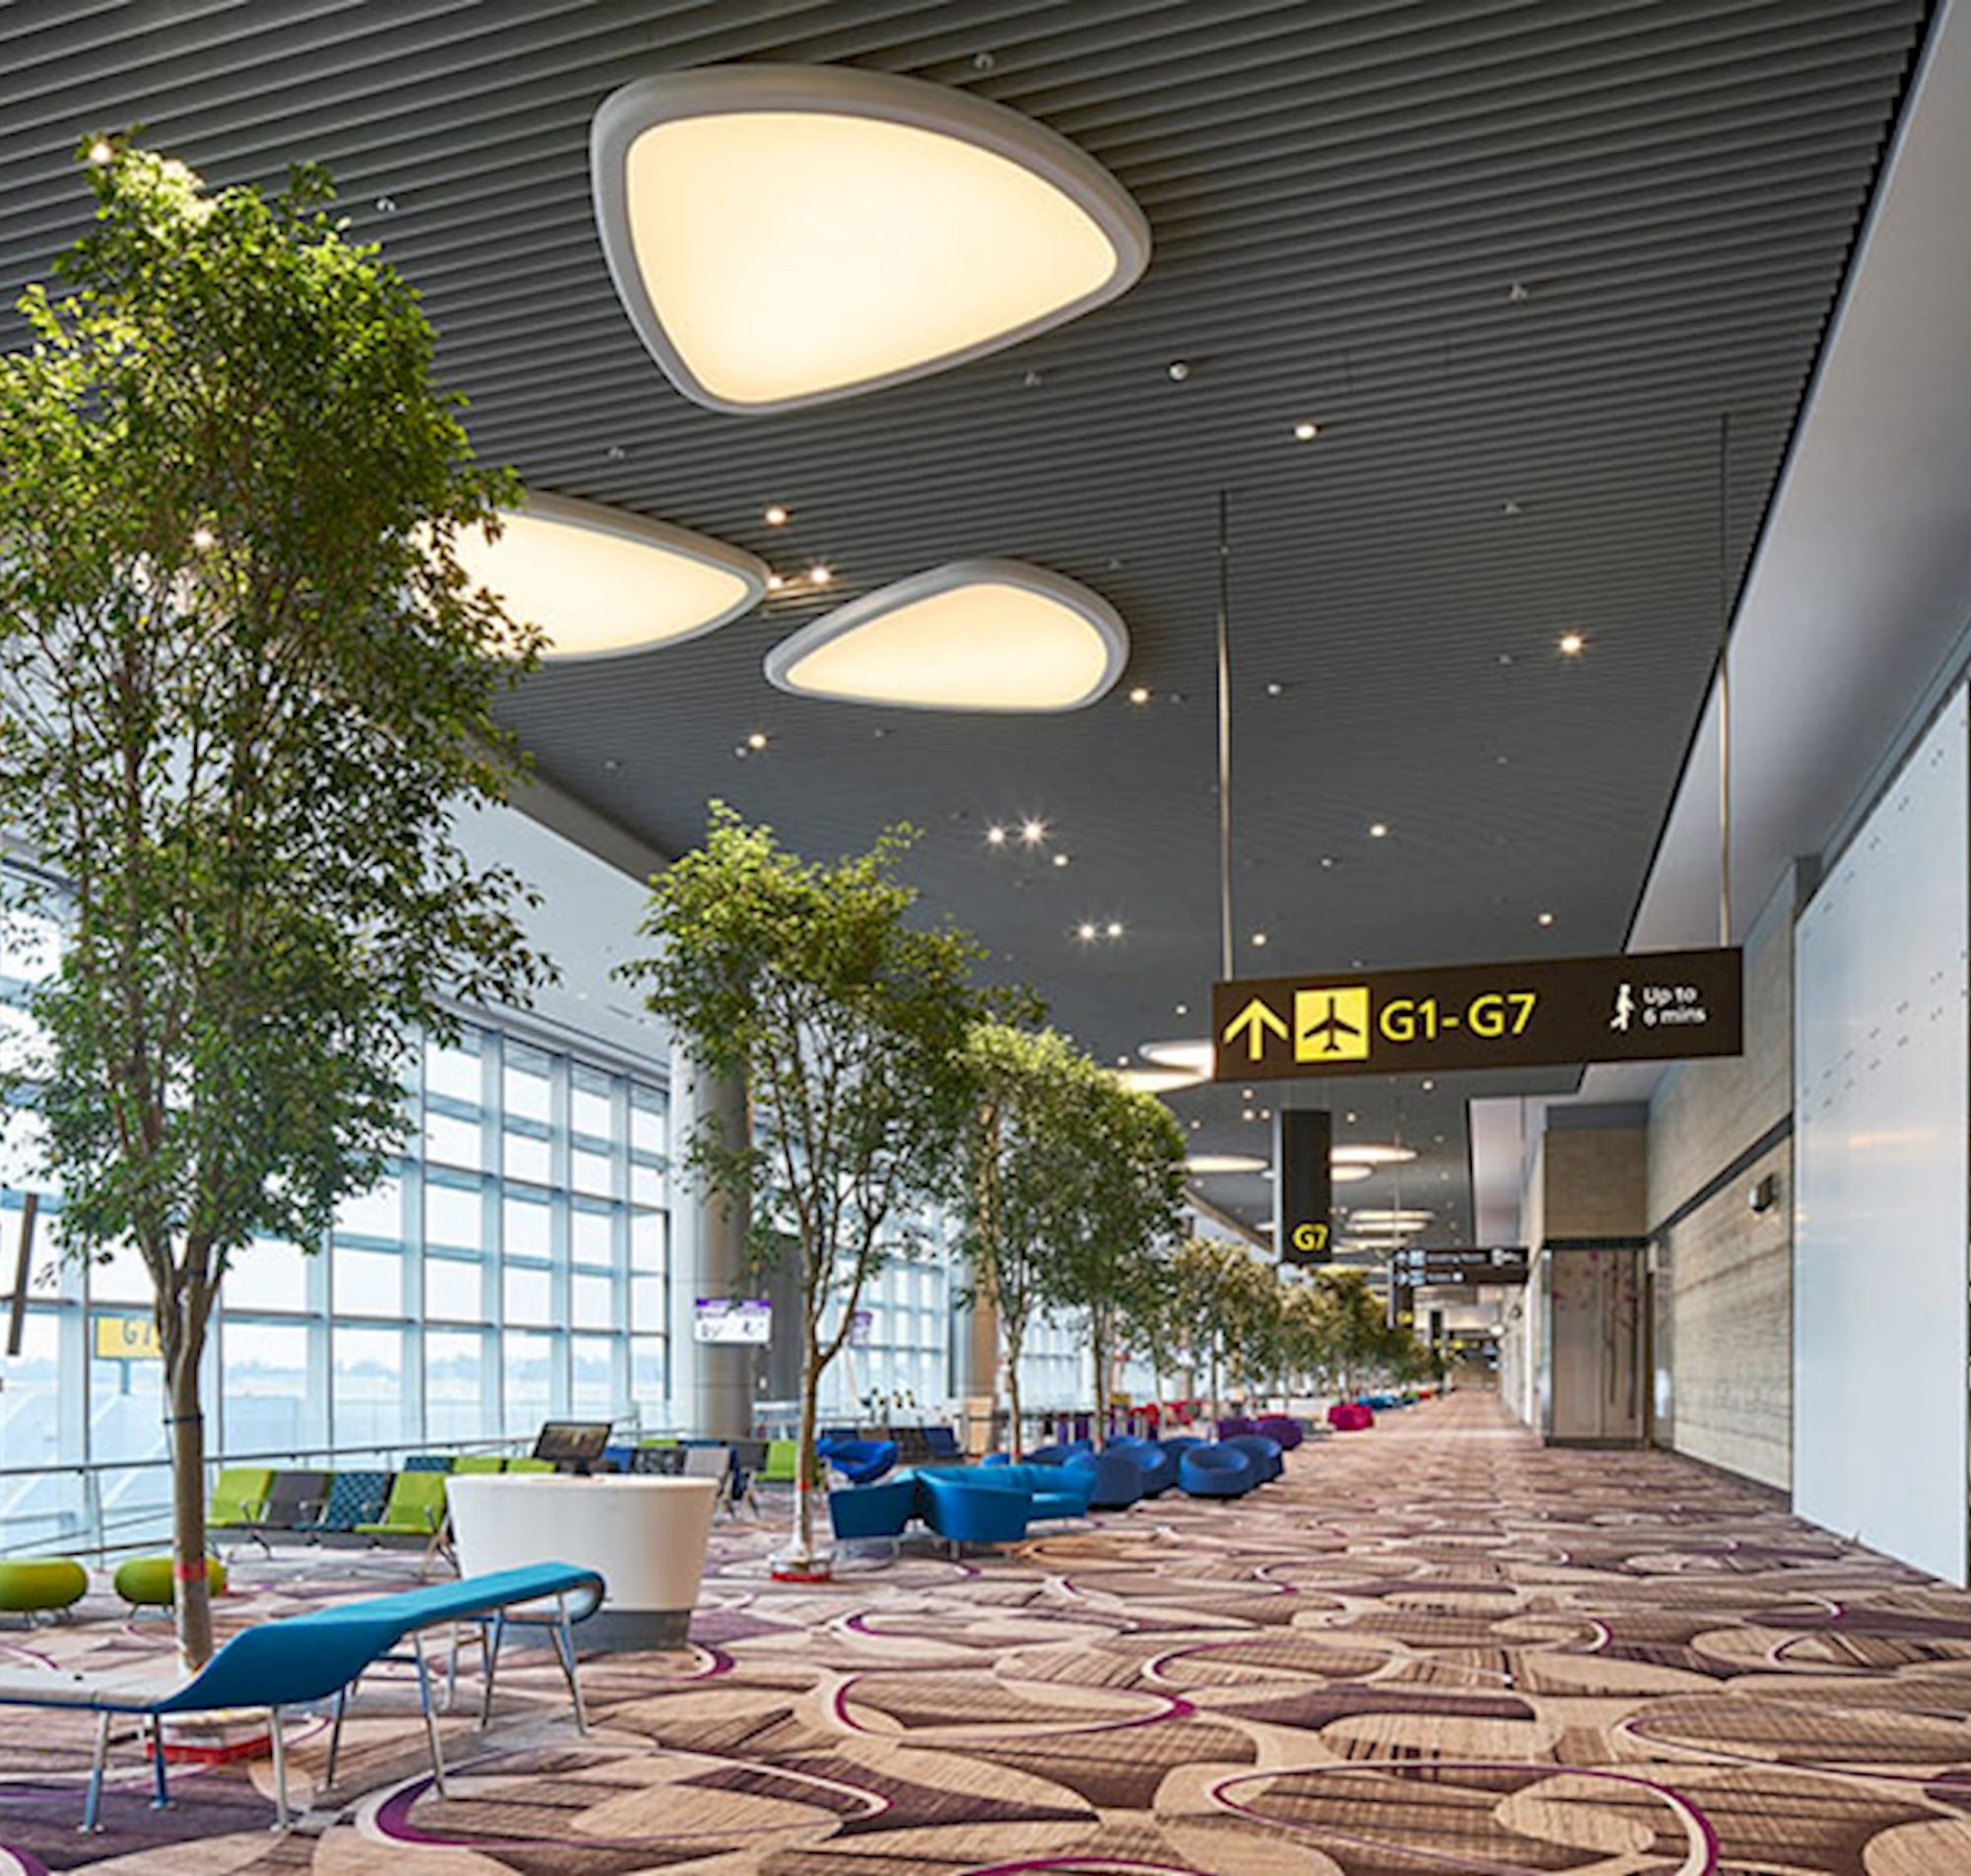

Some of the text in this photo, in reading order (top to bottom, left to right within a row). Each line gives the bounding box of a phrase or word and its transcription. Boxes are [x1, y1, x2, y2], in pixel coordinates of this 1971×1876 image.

[1643, 986, 1698, 1008] Up to
[1660, 1004, 1707, 1025] mins
[1292, 1224, 1328, 1251] G7
